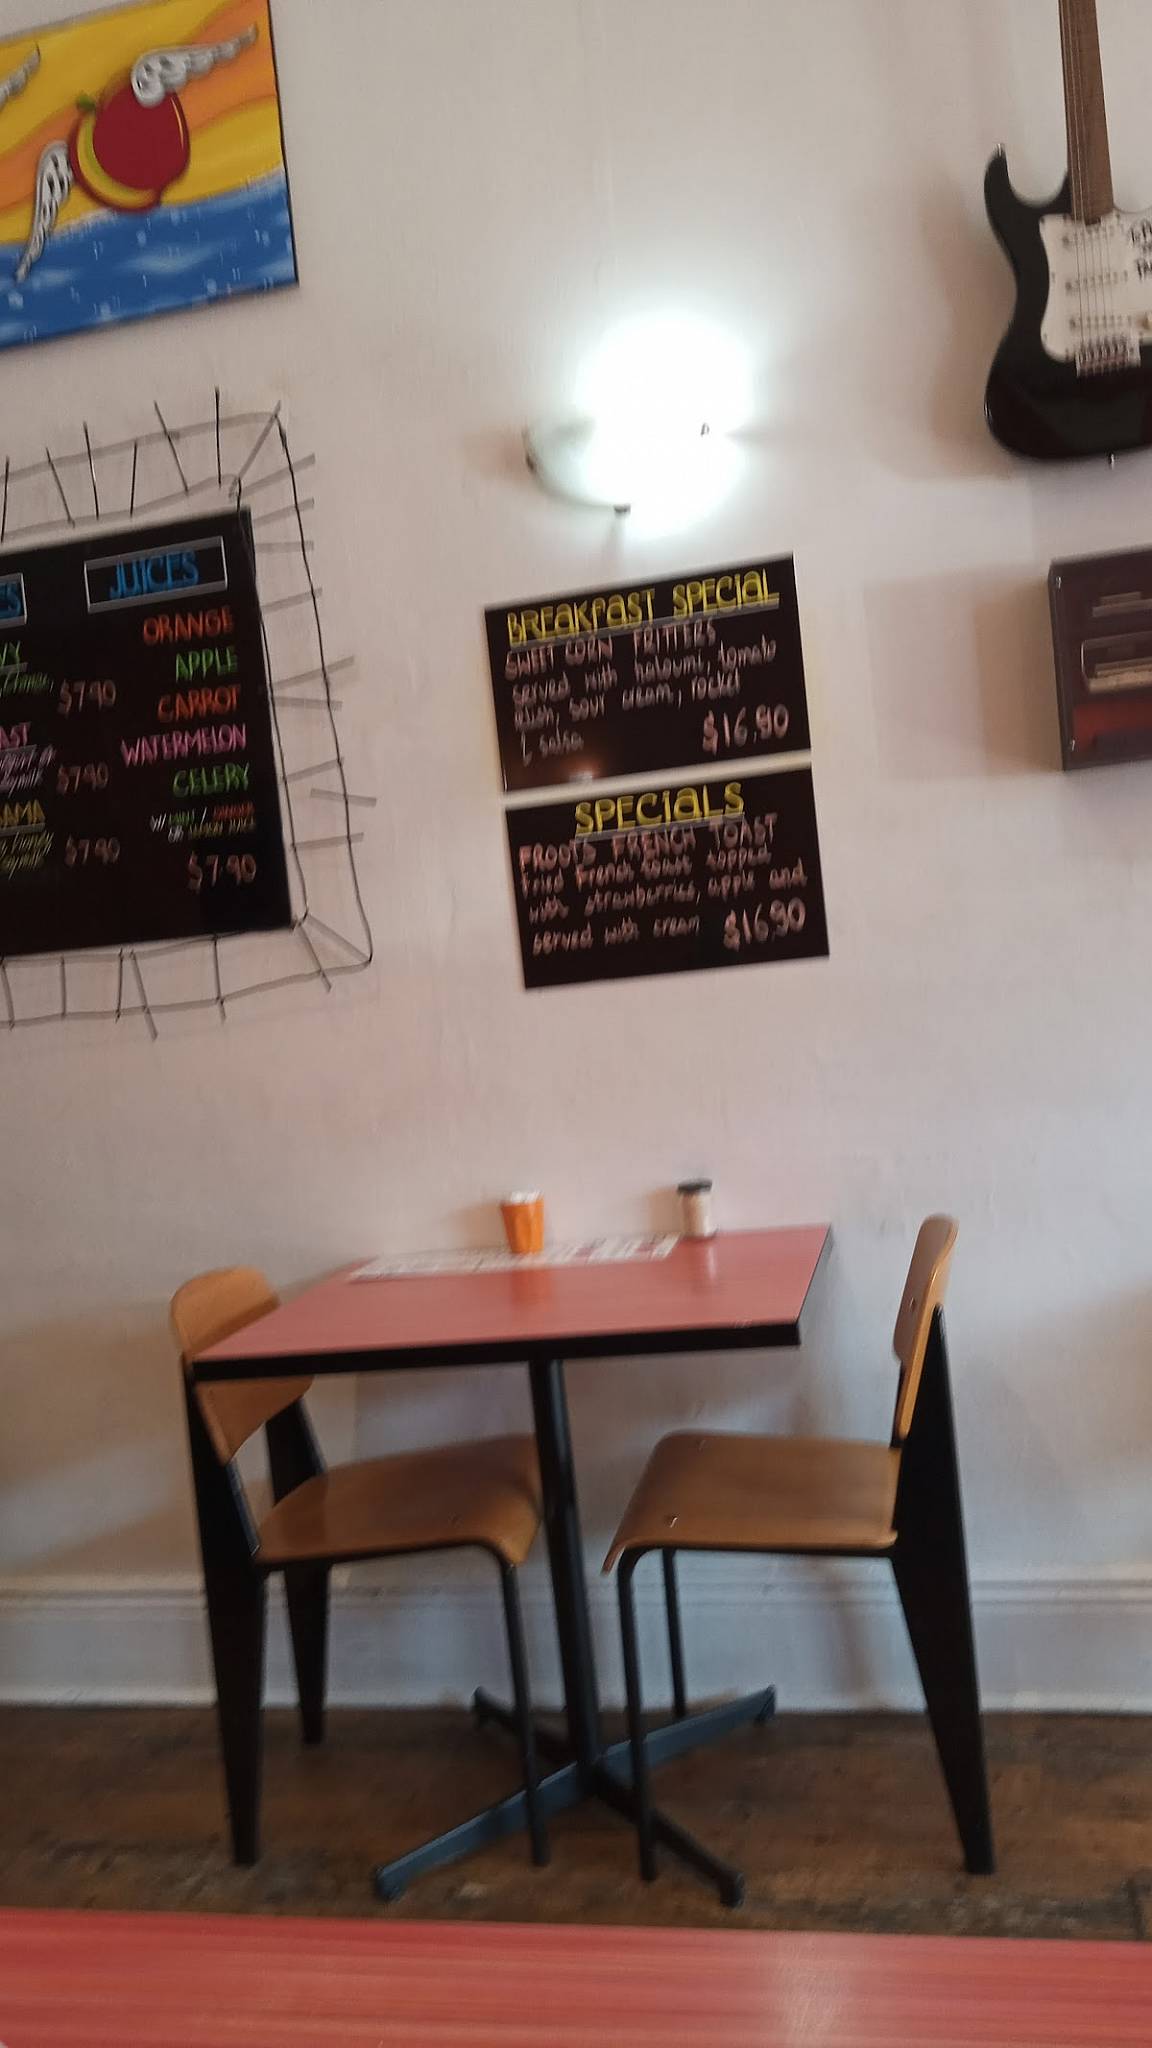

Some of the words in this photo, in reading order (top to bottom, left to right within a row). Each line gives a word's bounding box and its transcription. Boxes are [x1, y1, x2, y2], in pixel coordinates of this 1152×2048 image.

[109, 551, 200, 599] JUICES
[142, 606, 235, 646] ORANGE
[507, 588, 656, 649] BREAKFAST
[672, 568, 780, 620] SPECIAL
[176, 646, 238, 682] APPLE
[565, 633, 614, 665] CORN
[718, 632, 777, 672] tomato
[157, 684, 241, 722] CARROT
[120, 722, 247, 768] WATERMELON
[173, 762, 249, 798] CELERY
[575, 781, 746, 836] SPECIALS
[611, 824, 697, 860] FRENCH
[709, 812, 777, 850] TOAST
